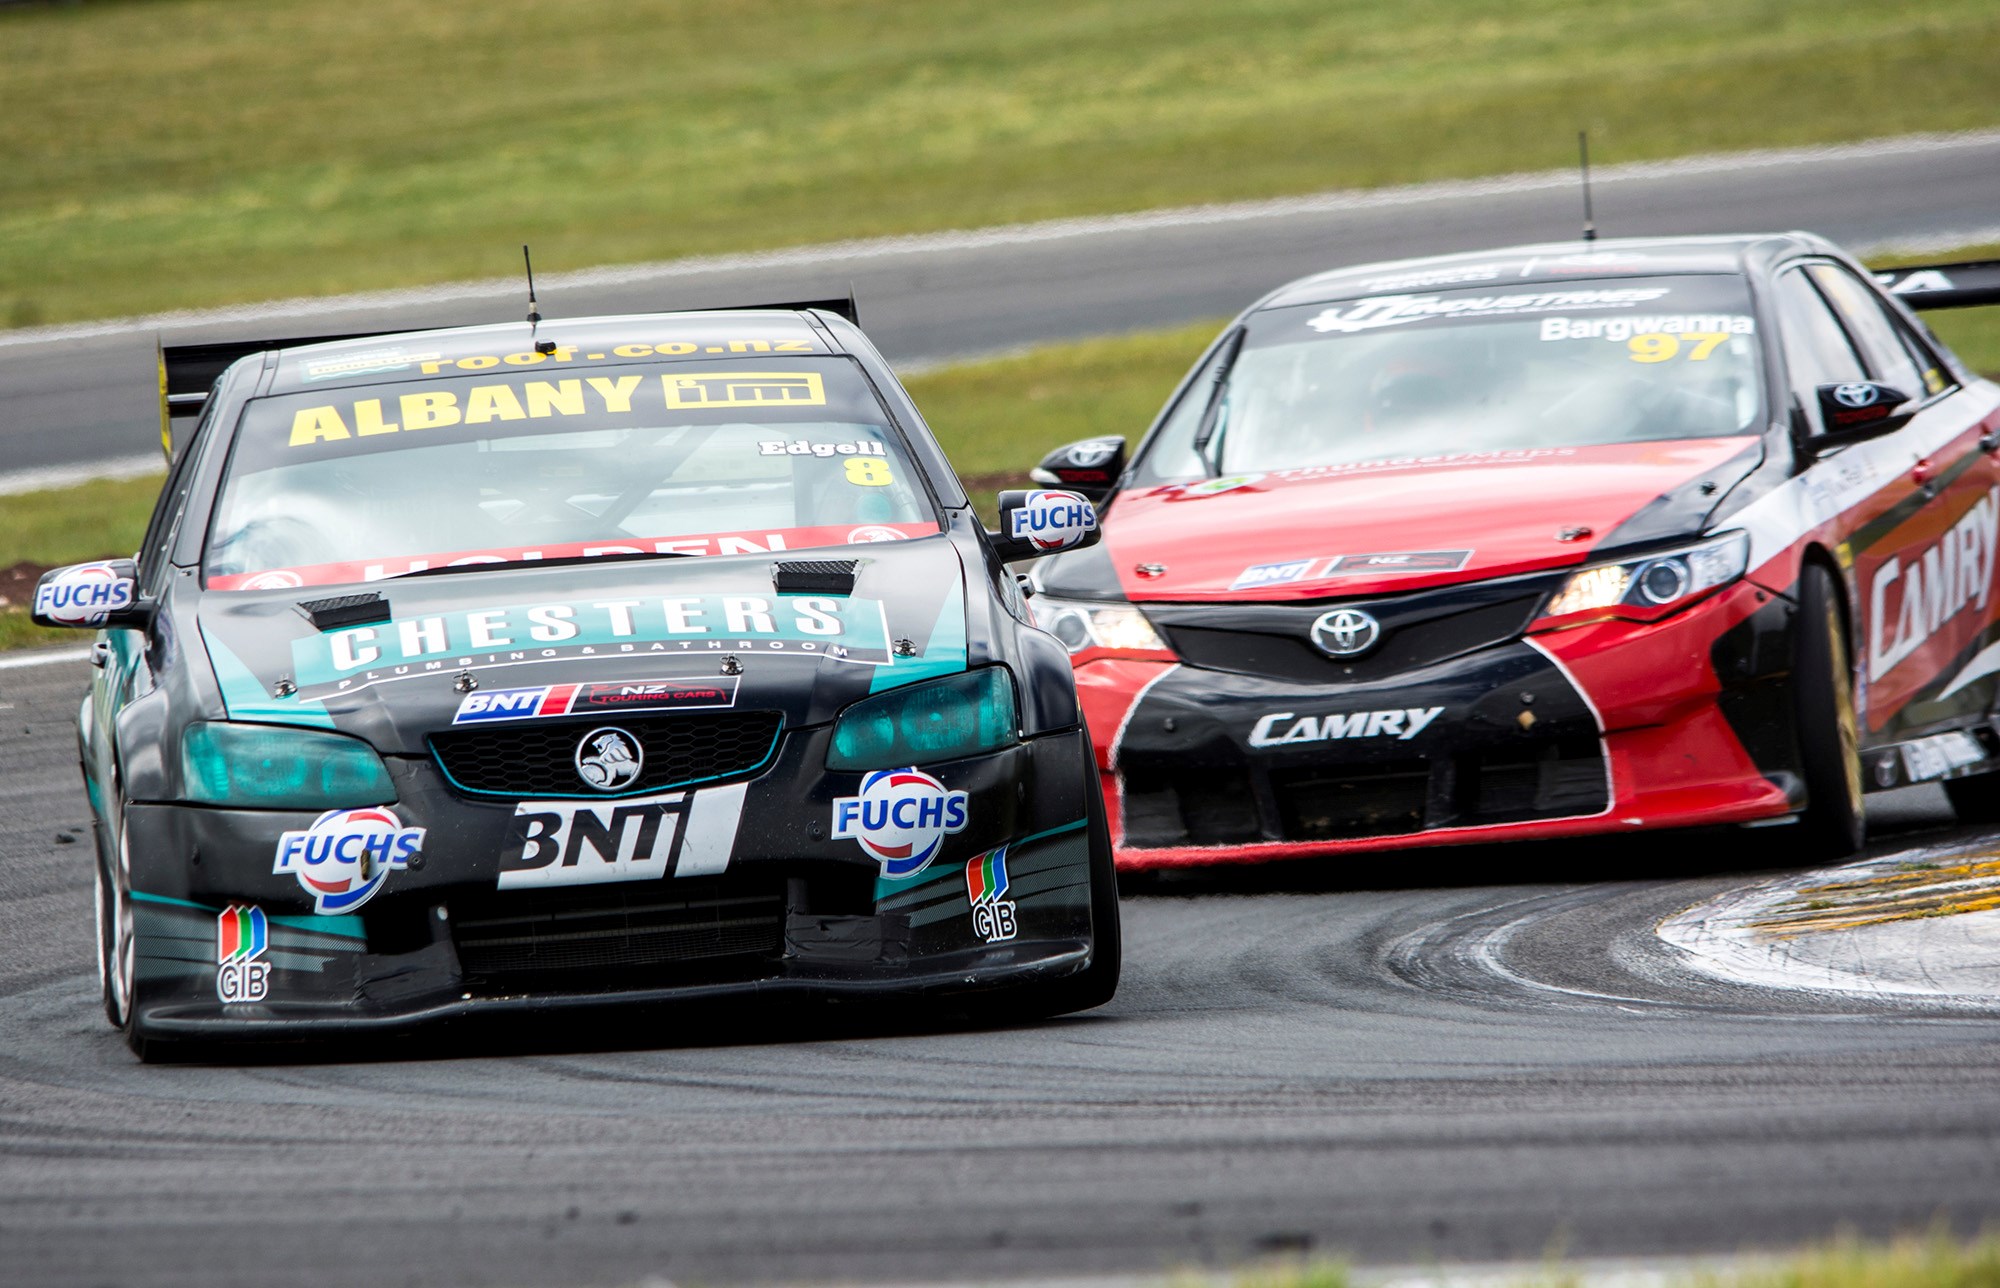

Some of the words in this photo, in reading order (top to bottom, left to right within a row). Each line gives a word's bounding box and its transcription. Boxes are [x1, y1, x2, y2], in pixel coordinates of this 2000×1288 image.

[1540, 313, 1755, 342] Bargwanna
[419, 339, 813, 375] roof.co.nz
[1627, 331, 1730, 364] 97
[288, 375, 644, 447] ALBANY
[758, 440, 888, 459] Edgell
[843, 457, 893, 487] 8
[1013, 504, 1096, 534] FUCHS
[1240, 561, 1308, 583] BNT
[1368, 556, 1413, 566] NZ
[38, 582, 130, 611] FUCHS
[1868, 485, 2000, 684] CAMRY
[330, 596, 845, 671] CHESTERS
[460, 691, 545, 714] BNT
[600, 692, 671, 704] TOURING
[673, 690, 717, 700] CARS
[620, 685, 668, 696] NZ
[1248, 706, 1446, 748] CAMRY
[837, 795, 966, 833] FUCHS
[280, 832, 421, 868] FUCHS
[973, 901, 1016, 944] GIB
[217, 962, 271, 1004] GIB
